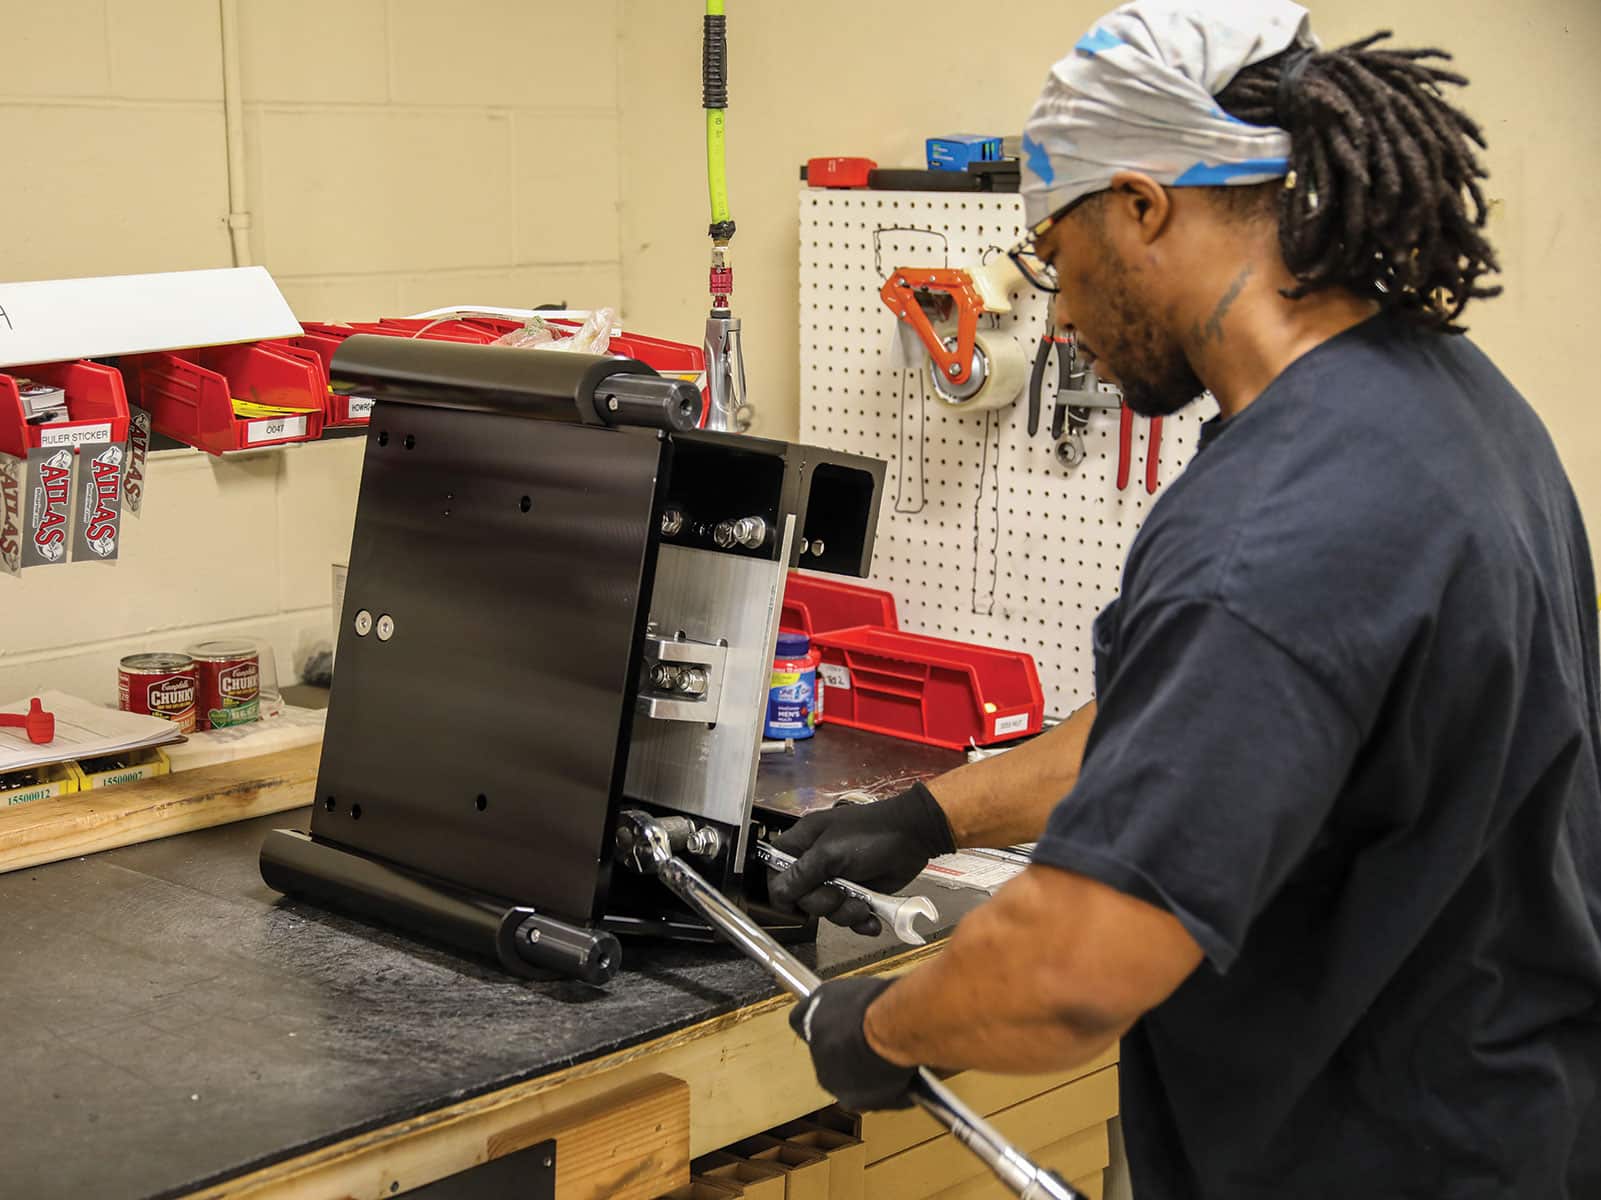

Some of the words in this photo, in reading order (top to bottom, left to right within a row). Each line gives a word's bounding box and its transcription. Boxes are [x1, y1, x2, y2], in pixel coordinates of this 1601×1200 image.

[42, 433, 70, 445] RULER
[71, 430, 108, 442] STICKER
[35, 462, 70, 545] ATLAS
[85, 459, 120, 541] ATLAS
[150, 687, 194, 706] CHUNKY
[103, 771, 143, 787] 15500007
[8, 788, 51, 806] 15500012
